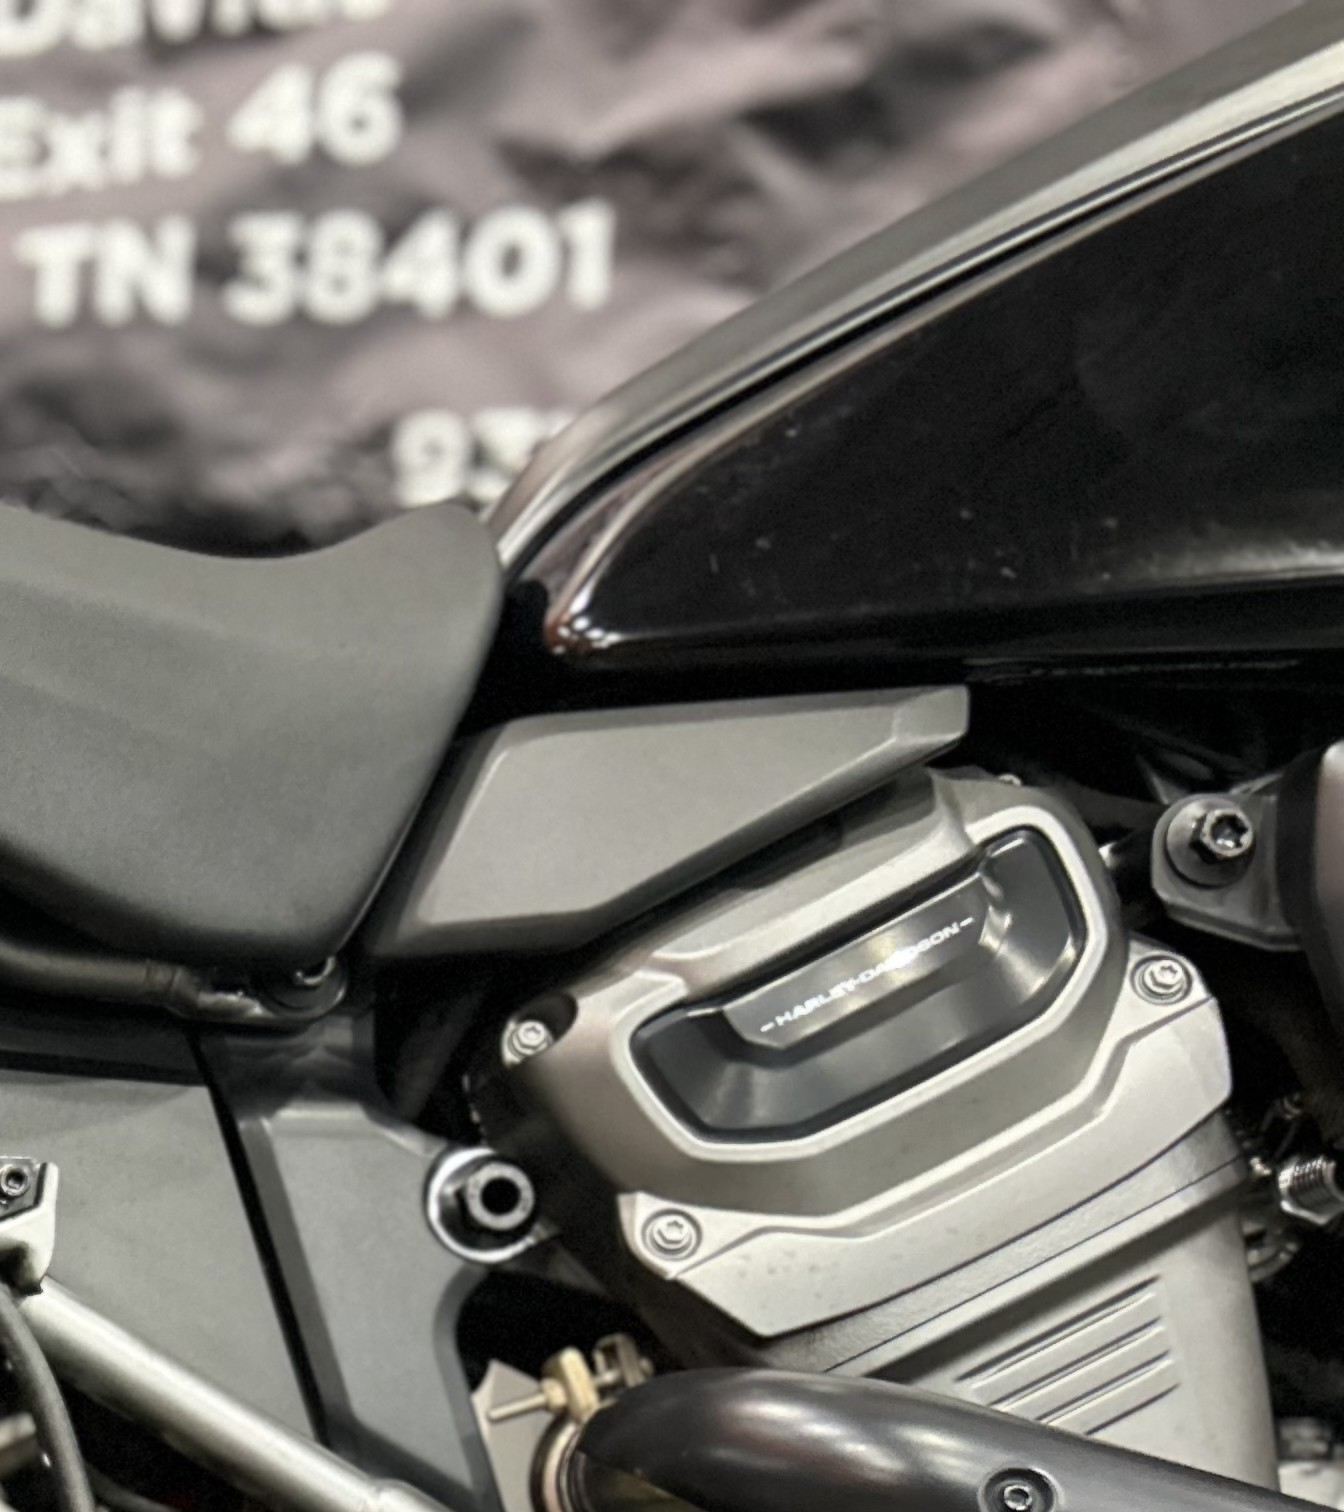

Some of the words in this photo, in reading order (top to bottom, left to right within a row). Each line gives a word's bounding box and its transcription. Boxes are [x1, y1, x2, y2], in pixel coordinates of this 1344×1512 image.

[227, 50, 404, 166] 46
[18, 213, 193, 328] TN
[225, 197, 614, 326] 38401
